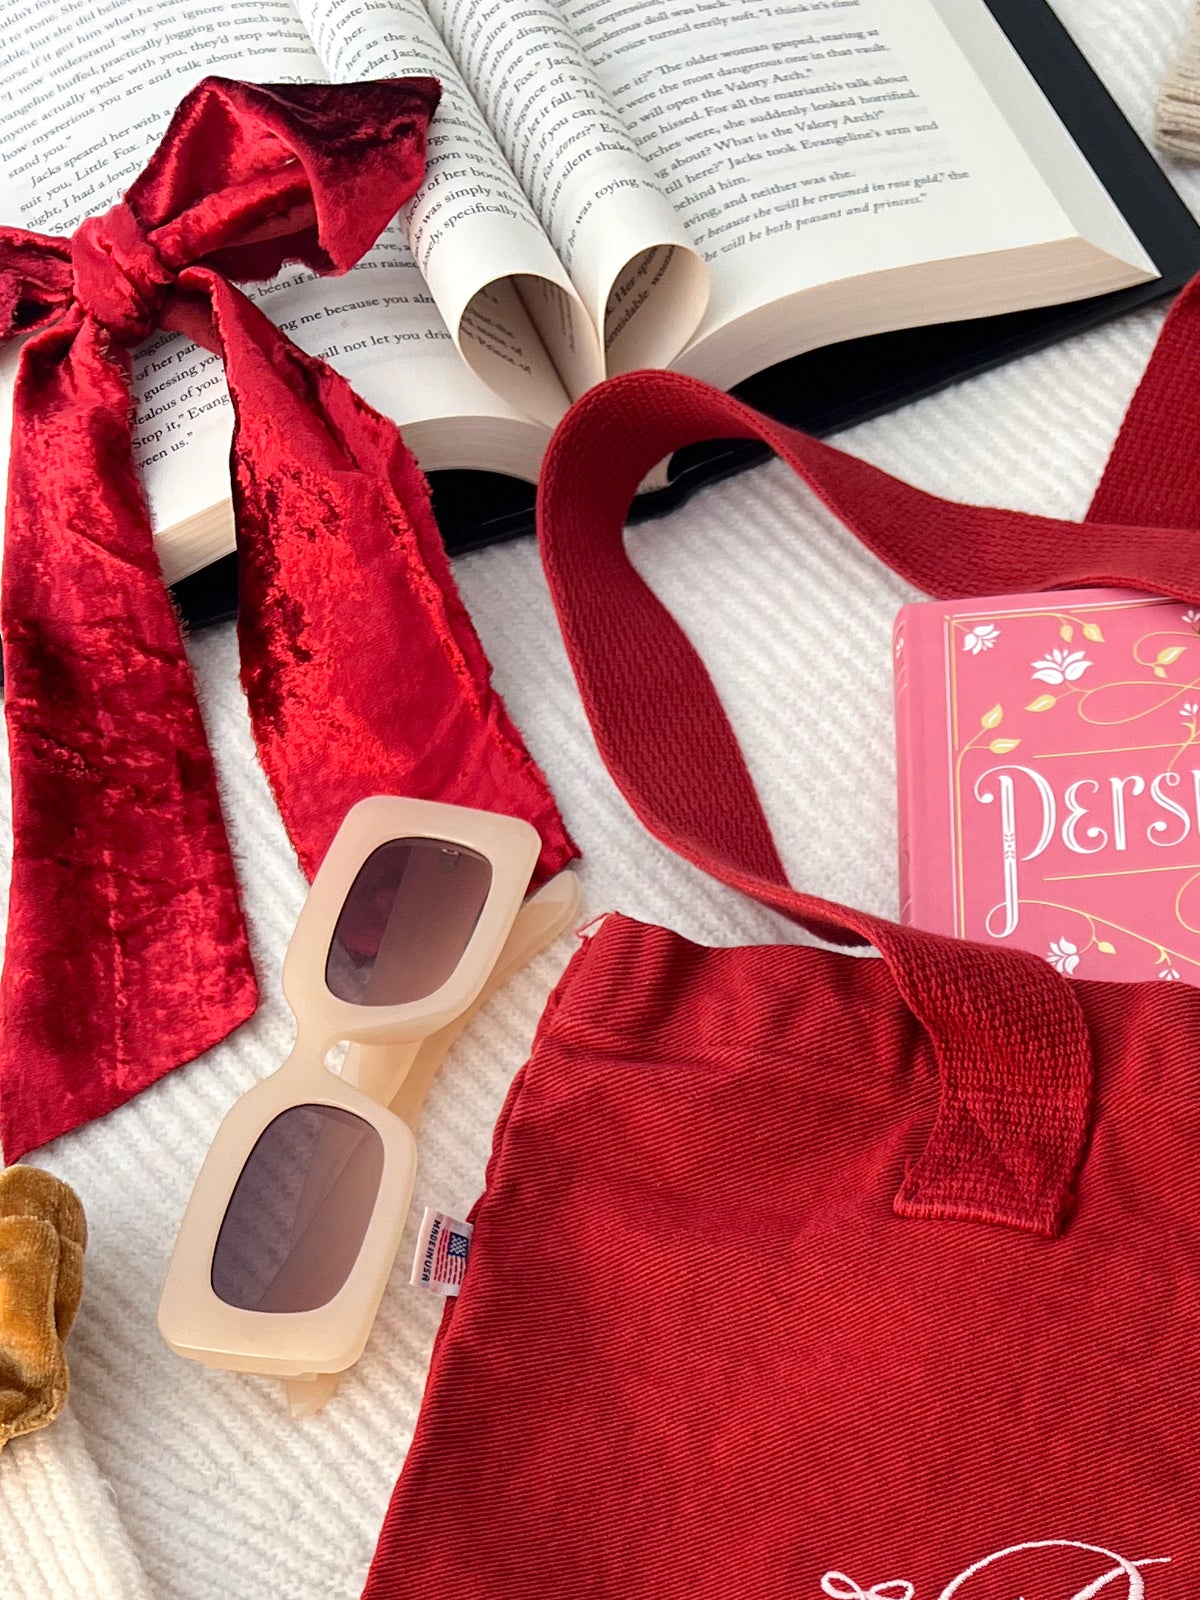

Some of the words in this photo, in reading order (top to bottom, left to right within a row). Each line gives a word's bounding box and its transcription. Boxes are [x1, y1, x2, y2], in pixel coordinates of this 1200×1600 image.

[50, 38, 115, 77] understand
[121, 26, 147, 41] why
[152, 15, 177, 29] you
[183, 4, 224, 20] ignore
[77, 29, 102, 45] him
[104, 12, 134, 31] what
[56, 66, 100, 93] huffed,
[101, 36, 163, 74] practically
[164, 23, 216, 44] jogging
[233, 14, 269, 25] catch
[360, 54, 390, 77] what
[41, 92, 86, 121] actually
[89, 73, 125, 96] spoke
[127, 58, 157, 76] with
[234, 32, 262, 43] stop
[658, 83, 680, 95] the
[716, 58, 782, 77] dangerous
[2, 144, 27, 163] how
[32, 106, 96, 147] mysterious
[98, 94, 122, 112] you
[125, 83, 145, 97] are
[148, 69, 172, 86] and
[176, 60, 202, 74] talk
[205, 51, 244, 66] about
[247, 47, 277, 57] how
[640, 106, 664, 121] will
[666, 95, 699, 111] open
[701, 88, 723, 99] the
[724, 77, 768, 92] Valory
[704, 105, 728, 117] For
[731, 99, 747, 110] all
[750, 94, 771, 105] the
[723, 119, 745, 130] she
[750, 106, 808, 124] suddenly
[810, 95, 856, 112] looked
[572, 108, 597, 119] can
[713, 136, 754, 151] What
[771, 127, 794, 138] the
[795, 118, 839, 132] Valory
[30, 164, 62, 190] Jacks
[63, 137, 108, 169] speared
[108, 127, 131, 143] her
[132, 113, 162, 131] with
[562, 149, 593, 180] silent
[727, 152, 763, 170] Jacks
[766, 145, 797, 158] took
[8, 155, 40, 180] stand
[19, 195, 42, 213] suit
[74, 158, 110, 183] Little
[112, 143, 142, 161] Fox.
[427, 174, 443, 191] of
[443, 168, 467, 181] her
[26, 207, 63, 230] night,
[72, 184, 95, 204] had
[107, 160, 143, 184] lovely
[594, 178, 640, 200] toying
[718, 176, 751, 190] him.
[723, 194, 748, 210] and
[751, 182, 797, 202] neither
[800, 175, 827, 186] was
[84, 196, 113, 218] away
[423, 202, 443, 224] was
[444, 185, 491, 203] simply
[443, 202, 518, 229] specifically
[796, 209, 842, 230] peasant
[845, 203, 869, 216] and
[708, 215, 750, 239] because
[258, 281, 292, 298] been
[300, 312, 322, 325] me
[324, 297, 380, 317] because
[383, 296, 409, 308] you
[343, 341, 367, 353] not
[371, 336, 389, 346] let
[393, 331, 421, 344] you
[151, 355, 172, 373] her
[144, 365, 198, 402] guessing
[180, 386, 193, 402] of
[428, 1219, 441, 1247] MADE
[426, 1247, 434, 1260] IN
[421, 1260, 432, 1281] USA
